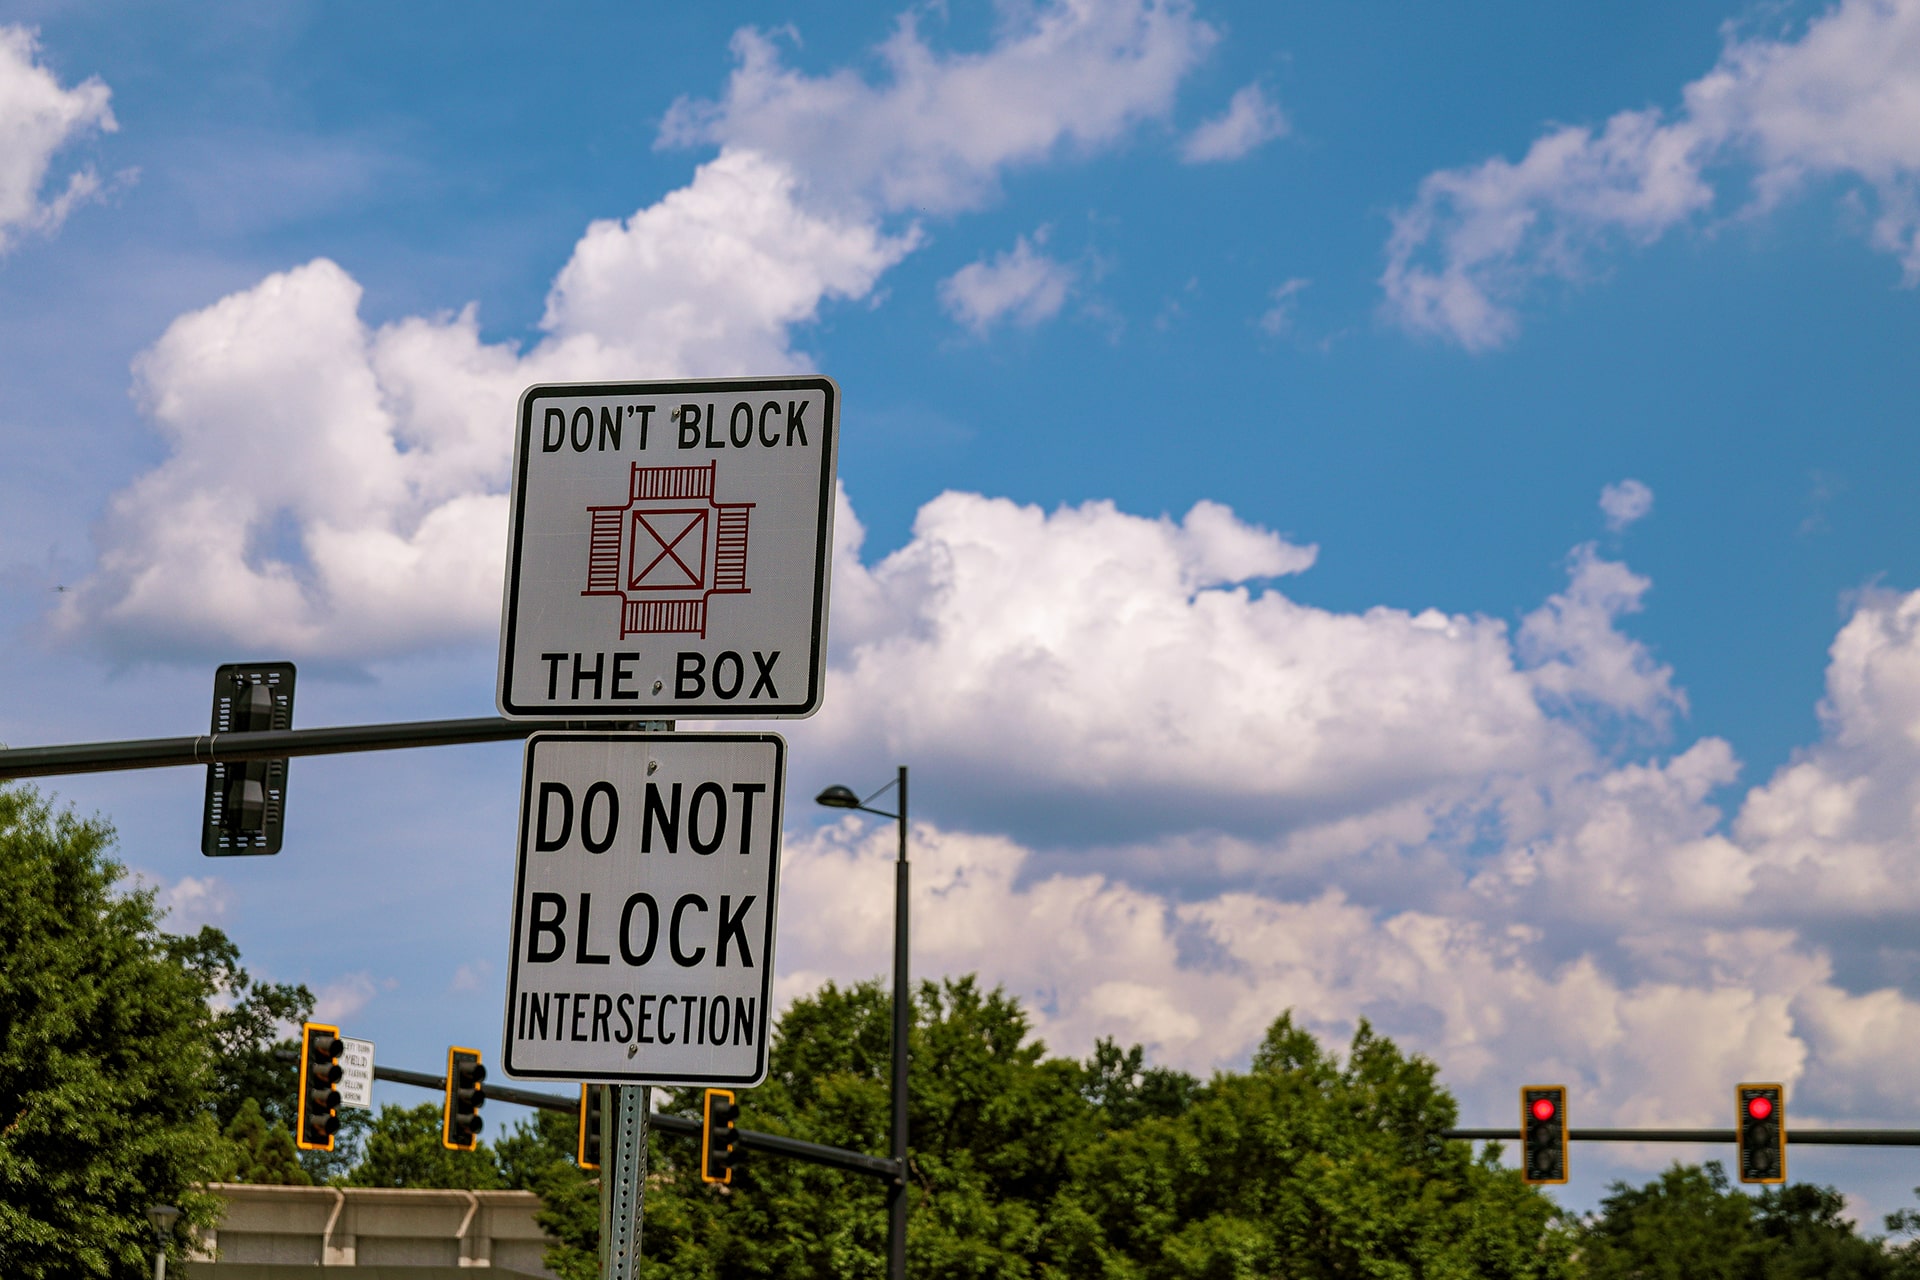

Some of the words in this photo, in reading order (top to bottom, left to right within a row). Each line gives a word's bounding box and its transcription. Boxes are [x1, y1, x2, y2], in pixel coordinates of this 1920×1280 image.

[542, 405, 656, 453] DON'T
[678, 401, 810, 450] BLOCK
[541, 652, 640, 700] THE
[674, 650, 781, 700] BOX
[535, 781, 620, 854] DO
[641, 781, 766, 855] NOT
[527, 892, 757, 968] BLOCK
[518, 992, 755, 1046] INTERSECTION
